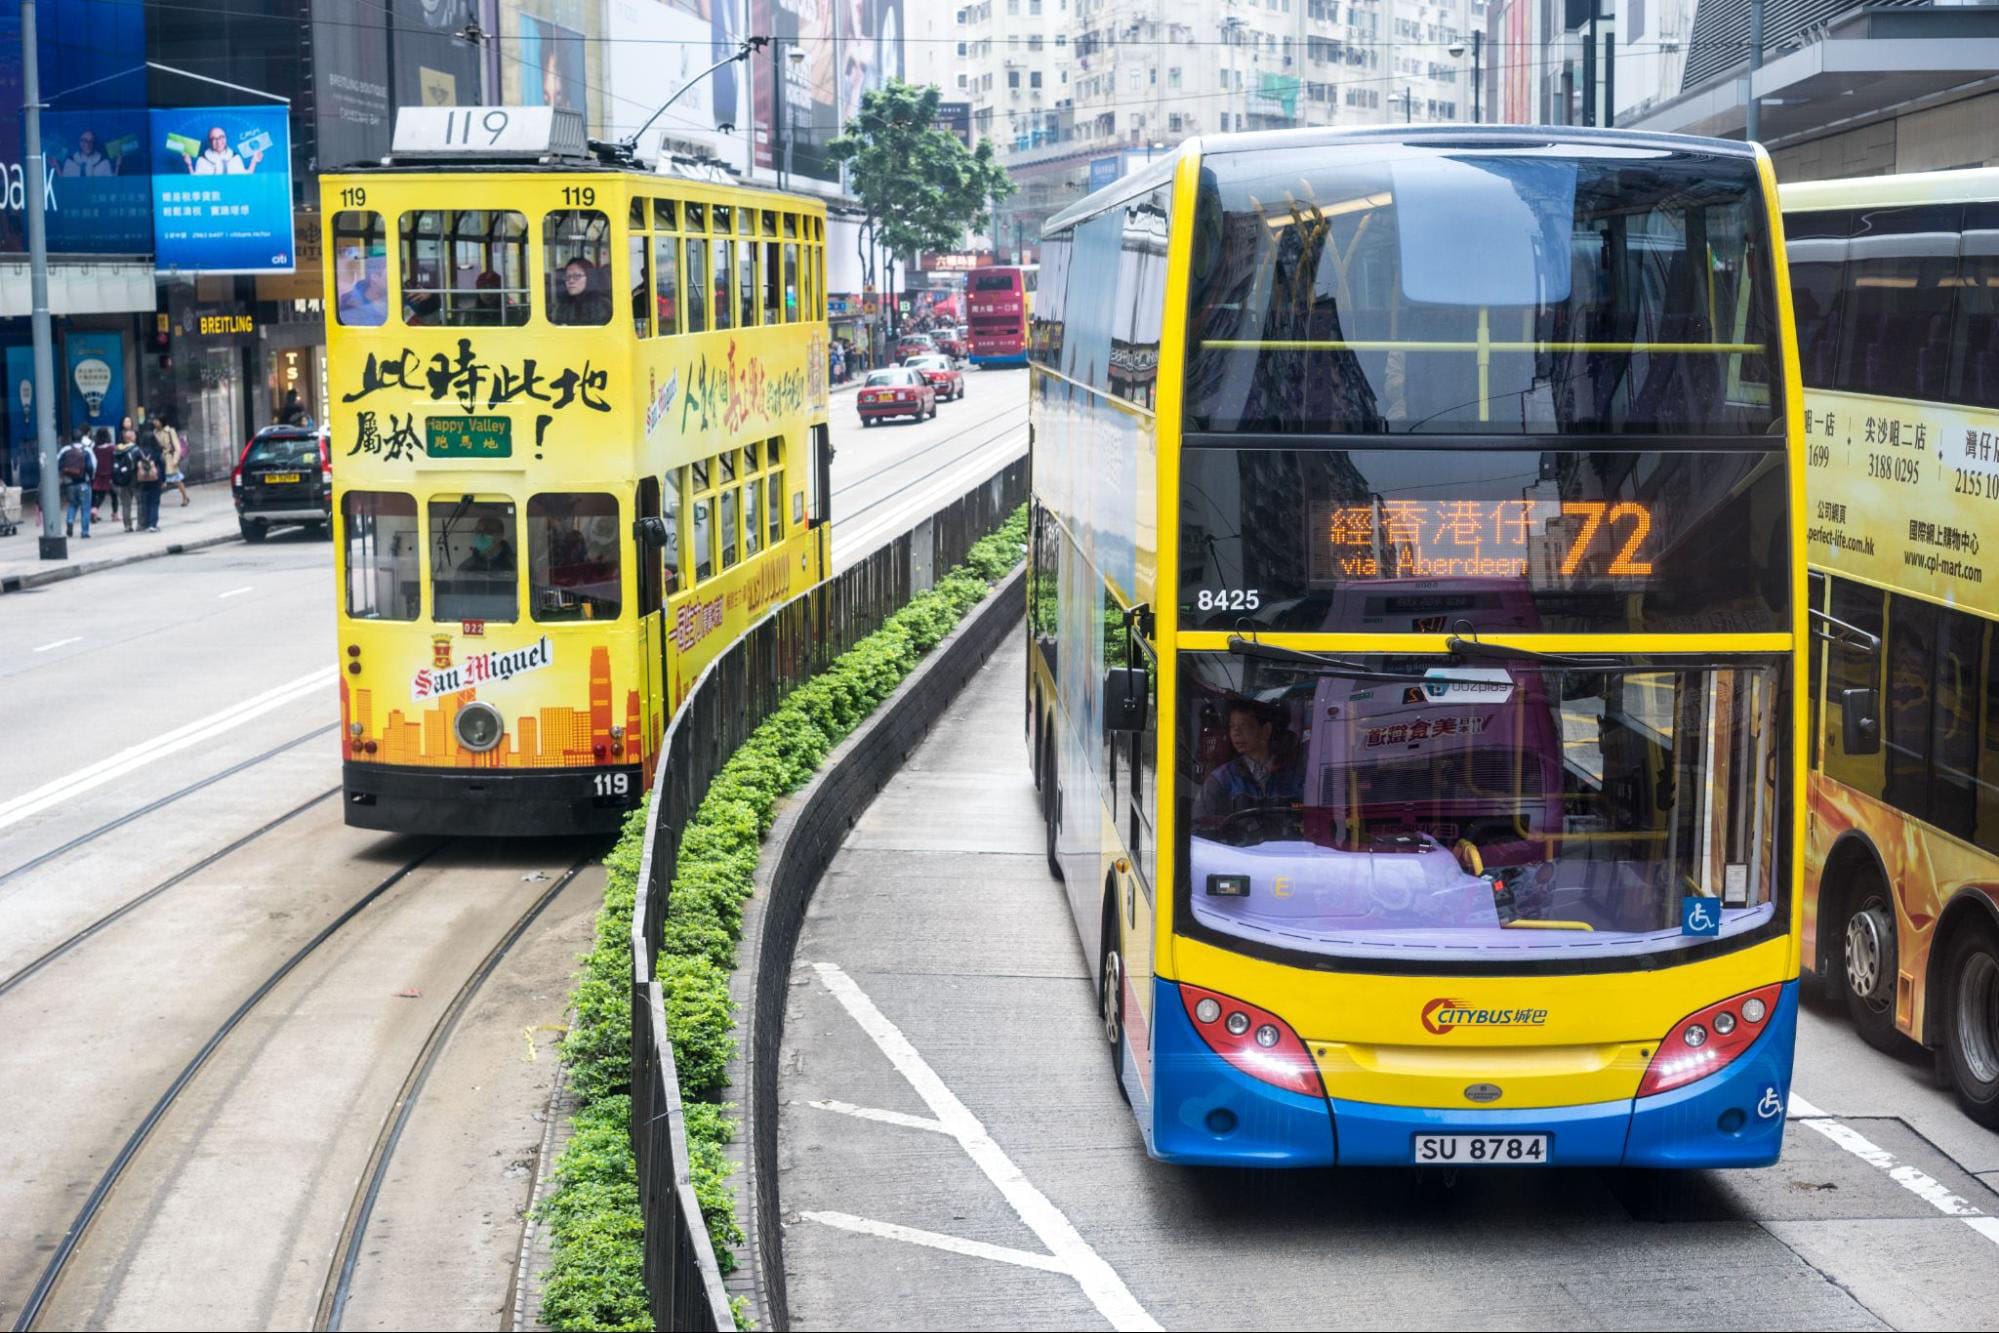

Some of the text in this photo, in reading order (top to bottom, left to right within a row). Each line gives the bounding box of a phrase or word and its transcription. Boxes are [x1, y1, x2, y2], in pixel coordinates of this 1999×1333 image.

[445, 110, 509, 145] 119
[340, 187, 366, 207] 119
[562, 186, 596, 206] 119
[271, 252, 287, 264] citi
[200, 316, 253, 335] BREITLING
[342, 339, 612, 414] 此時此地
[347, 411, 424, 462] 屬於
[426, 418, 505, 435] Happy Valley
[1865, 416, 1926, 450] 尖沙咀二店
[433, 434, 499, 449] 跑馬地
[1808, 444, 1999, 500] 1699 3188 0295 2155 10
[1330, 500, 1653, 575] 經香港仔 72
[1341, 545, 1528, 576] via Aberdeen
[1904, 550, 1983, 584] www.cpl-mart.com
[1197, 589, 1260, 611] 8425
[414, 635, 549, 697] San Miguel
[593, 773, 629, 797] 119
[1437, 1008, 1548, 1024] CITYBUS 城巴
[1421, 1138, 1542, 1160] SU 8784
